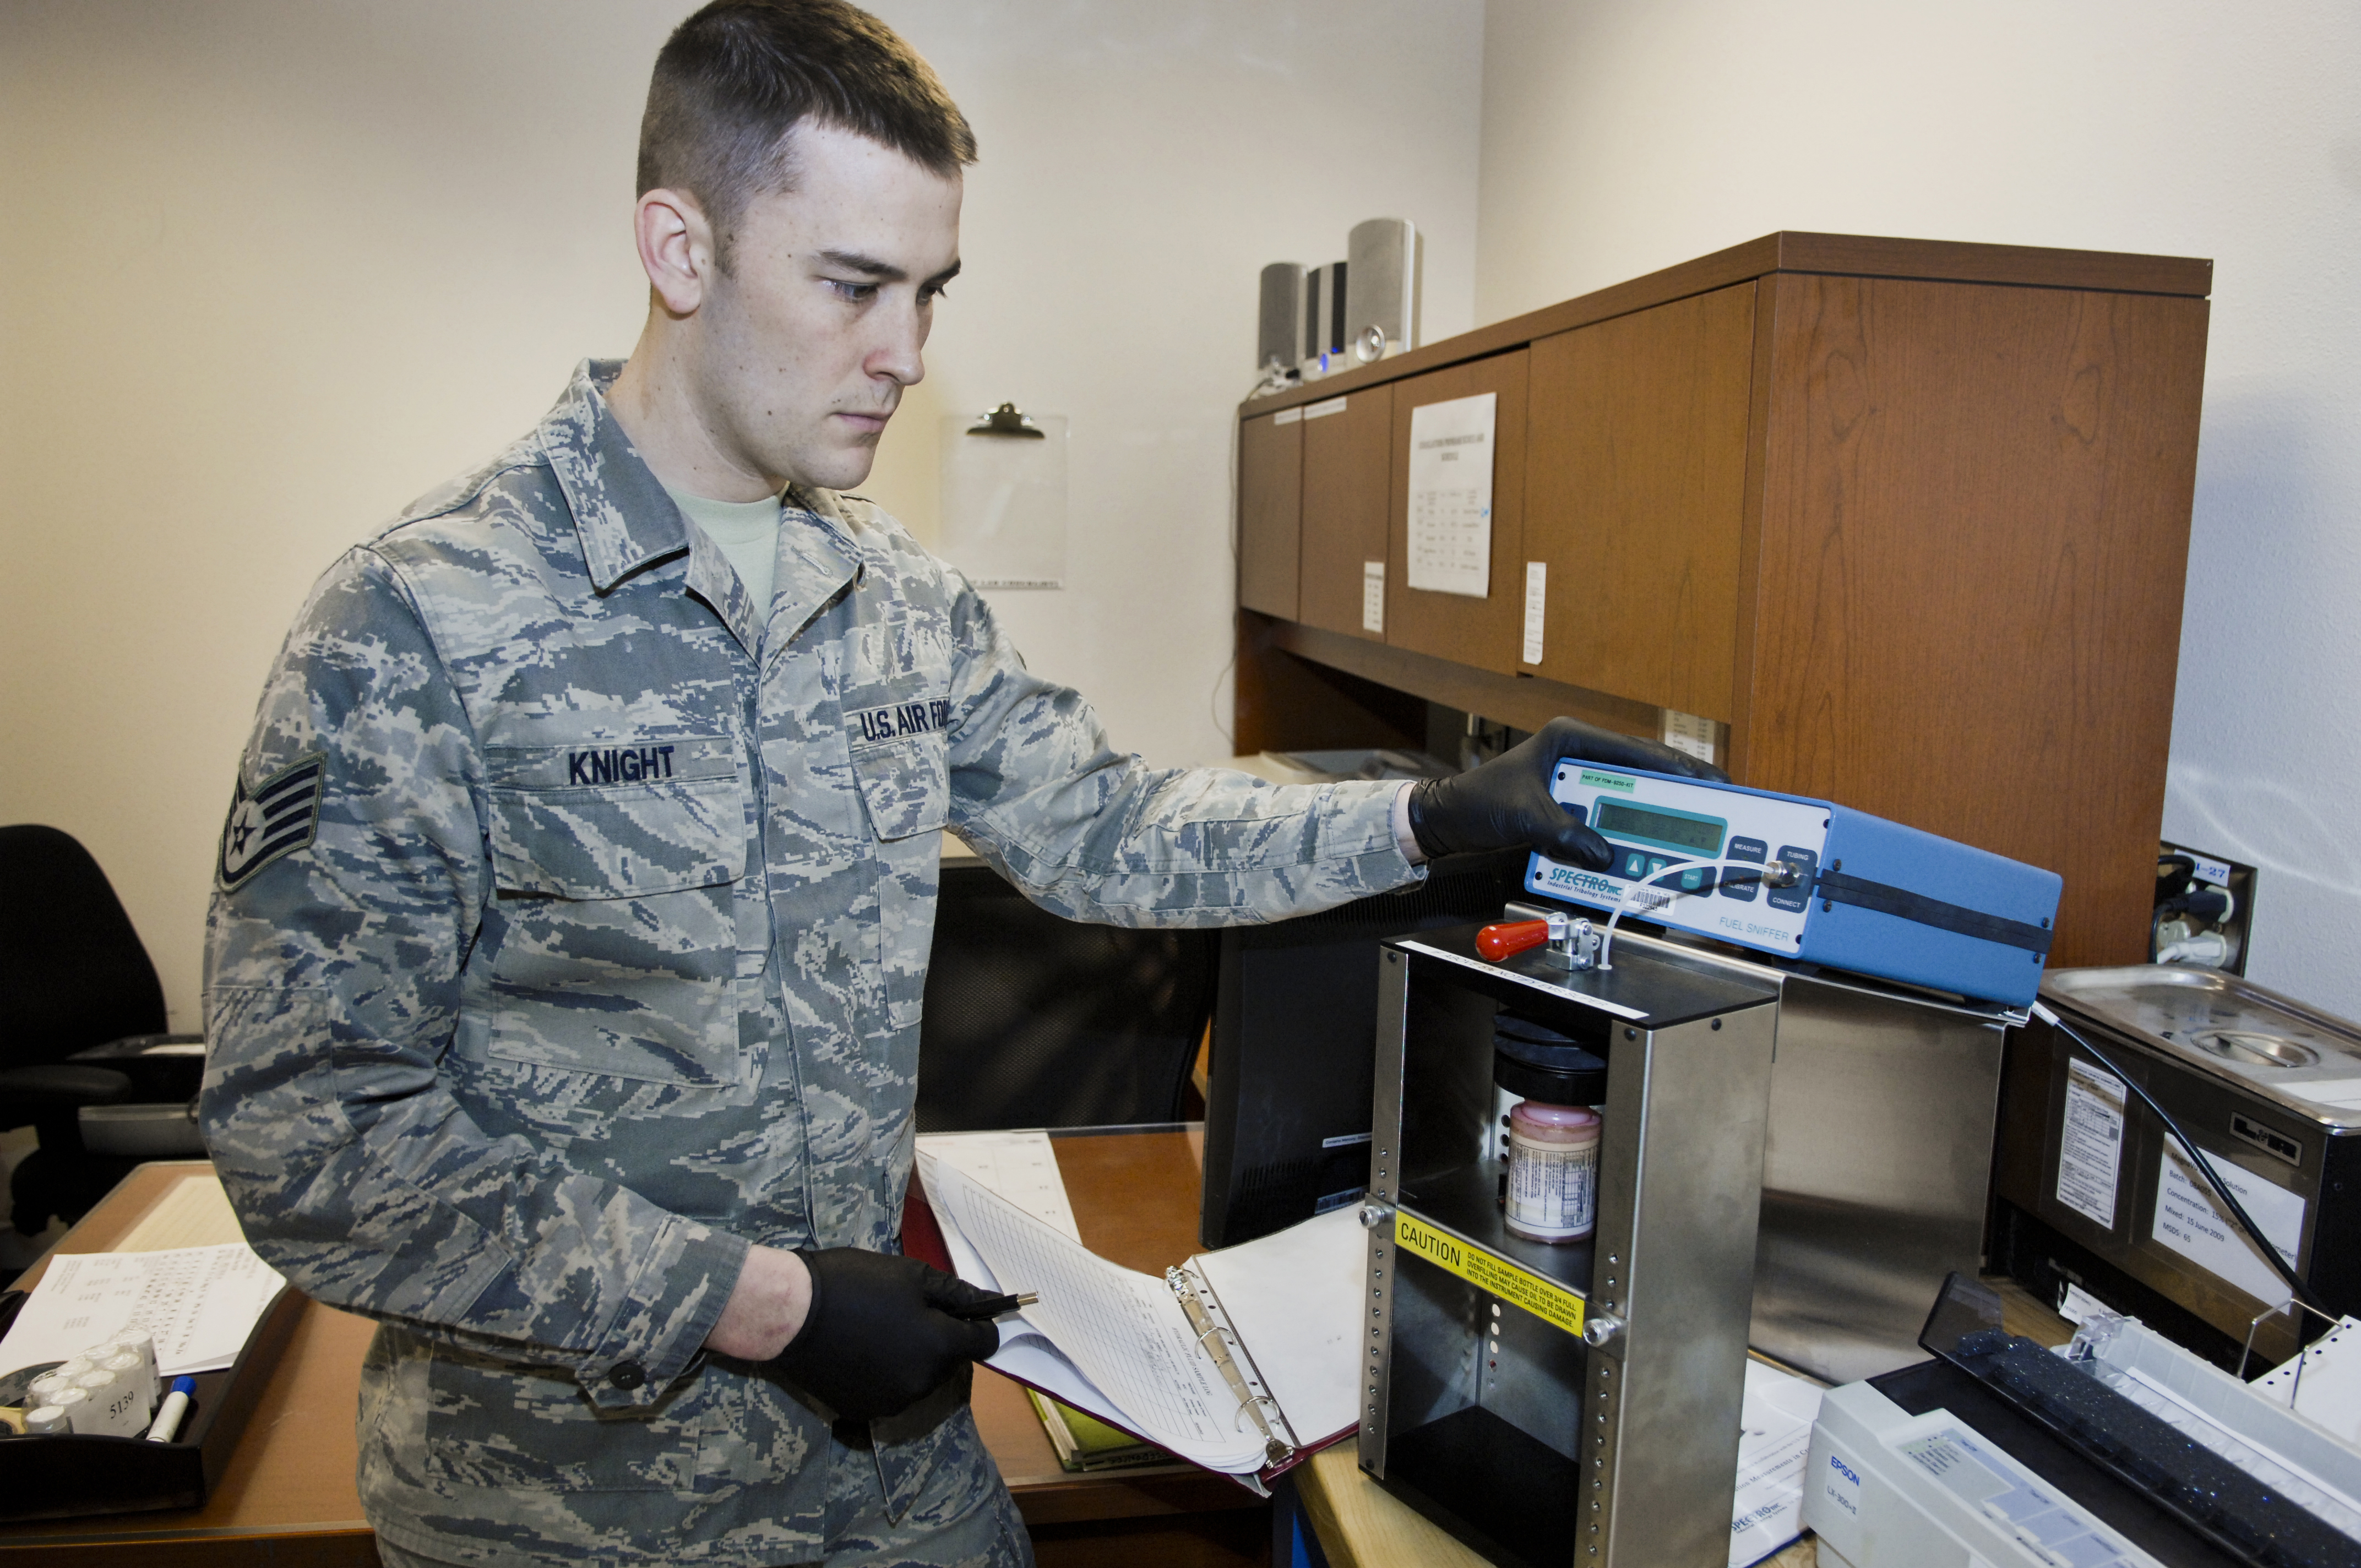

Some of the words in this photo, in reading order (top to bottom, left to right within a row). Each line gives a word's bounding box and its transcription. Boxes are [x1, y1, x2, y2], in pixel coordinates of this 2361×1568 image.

[859, 710, 896, 742] U.S.
[896, 704, 929, 736] AIR
[569, 745, 674, 786] KNIGHT
[1734, 843, 1761, 853] MEASURE
[1787, 851, 1809, 861] TUBING
[1547, 880, 1573, 890] Industrial
[1574, 887, 1598, 898] Tribology
[1600, 893, 1620, 902] Systems
[1549, 868, 1609, 891] SPECTRO
[1772, 897, 1801, 908] CONNECT
[1719, 917, 1743, 931] FUEL
[1746, 923, 1789, 941] SNIFFER
[2169, 1170, 2187, 1184] Batch:
[2223, 1178, 2248, 1195] Solution
[2167, 1188, 2208, 1215] Concentration:
[2212, 1211, 2224, 1223] 15%
[2163, 1222, 2181, 1237] MSDS:
[2183, 1234, 2191, 1243] 65
[2165, 1205, 2184, 1220] Mixed:
[2187, 1217, 2194, 1226] 15
[2195, 1221, 2208, 1234] June
[2210, 1229, 2224, 1242] 2009
[1401, 1222, 1460, 1267] CAUTION
[1468, 1252, 1475, 1260] DO
[1476, 1256, 1486, 1266] NOT
[1487, 1261, 1497, 1272] FILL
[1498, 1267, 1518, 1282] SAMPLE
[1519, 1277, 1538, 1292] BOTTLE
[1539, 1288, 1553, 1299] OVER
[1467, 1260, 1498, 1281] OVERFILLING
[1499, 1276, 1510, 1287] MAY
[1511, 1282, 1528, 1296] CAUSE
[1539, 1295, 1546, 1304] TO
[1547, 1300, 1554, 1309] BE
[1555, 1304, 1576, 1320] DRAWN
[1467, 1268, 1478, 1280] INTO
[1479, 1275, 1489, 1285] THE
[1490, 1280, 1523, 1302] INSTRUMENT
[1524, 1297, 1547, 1314] CAUSING
[1548, 1310, 1574, 1328] DAMAGE.
[1172, 1327, 1189, 1353] HYDRAULIC
[1185, 1352, 1196, 1366] FLUID
[1193, 1366, 1207, 1385] SAMPLE
[1202, 1386, 1212, 1396] LOG
[110, 1391, 134, 1419] 5139
[1749, 1459, 1793, 1483] Measurements
[1831, 1455, 1860, 1487] EPSON
